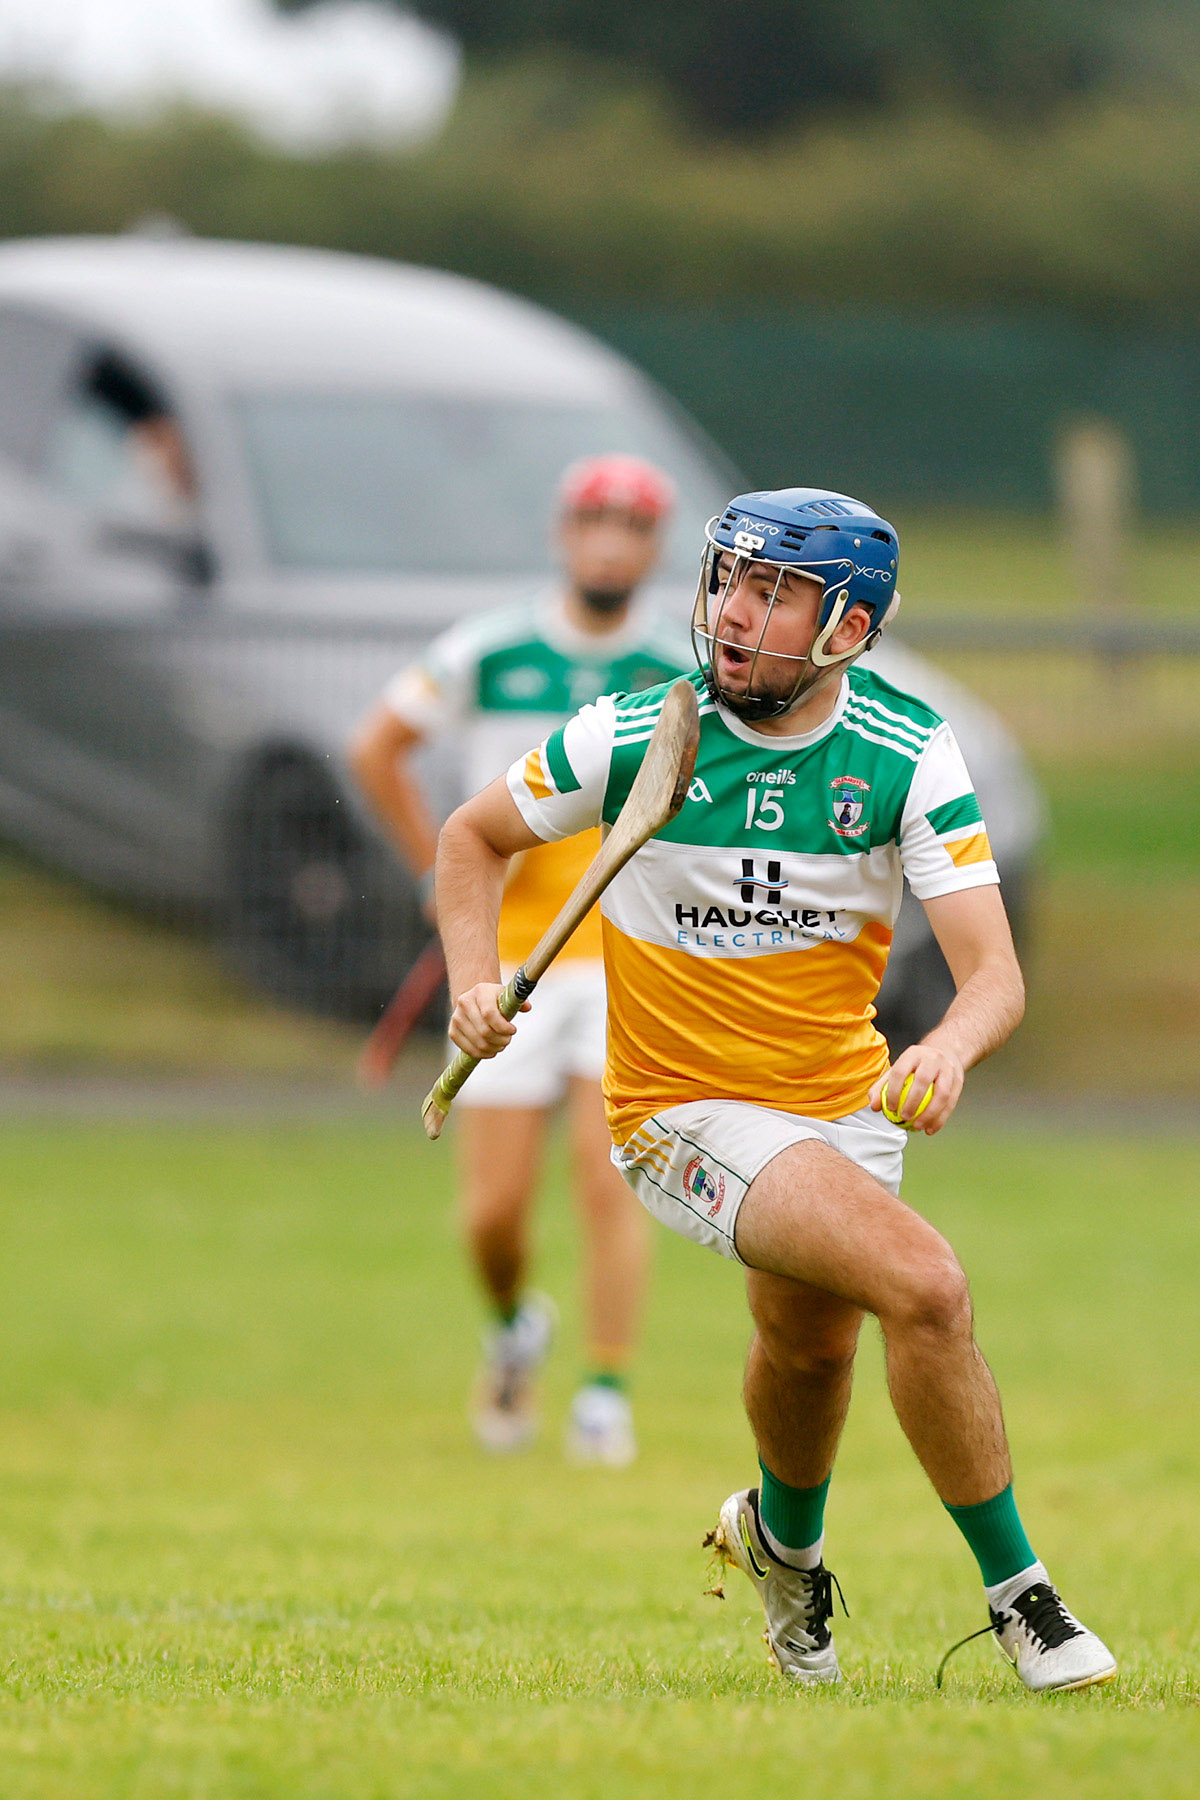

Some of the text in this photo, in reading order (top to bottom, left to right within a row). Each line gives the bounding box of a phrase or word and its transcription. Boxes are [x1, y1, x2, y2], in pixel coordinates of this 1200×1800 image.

[736, 517, 780, 536] Mycro
[837, 561, 892, 583] Mycro
[744, 787, 785, 831] 15
